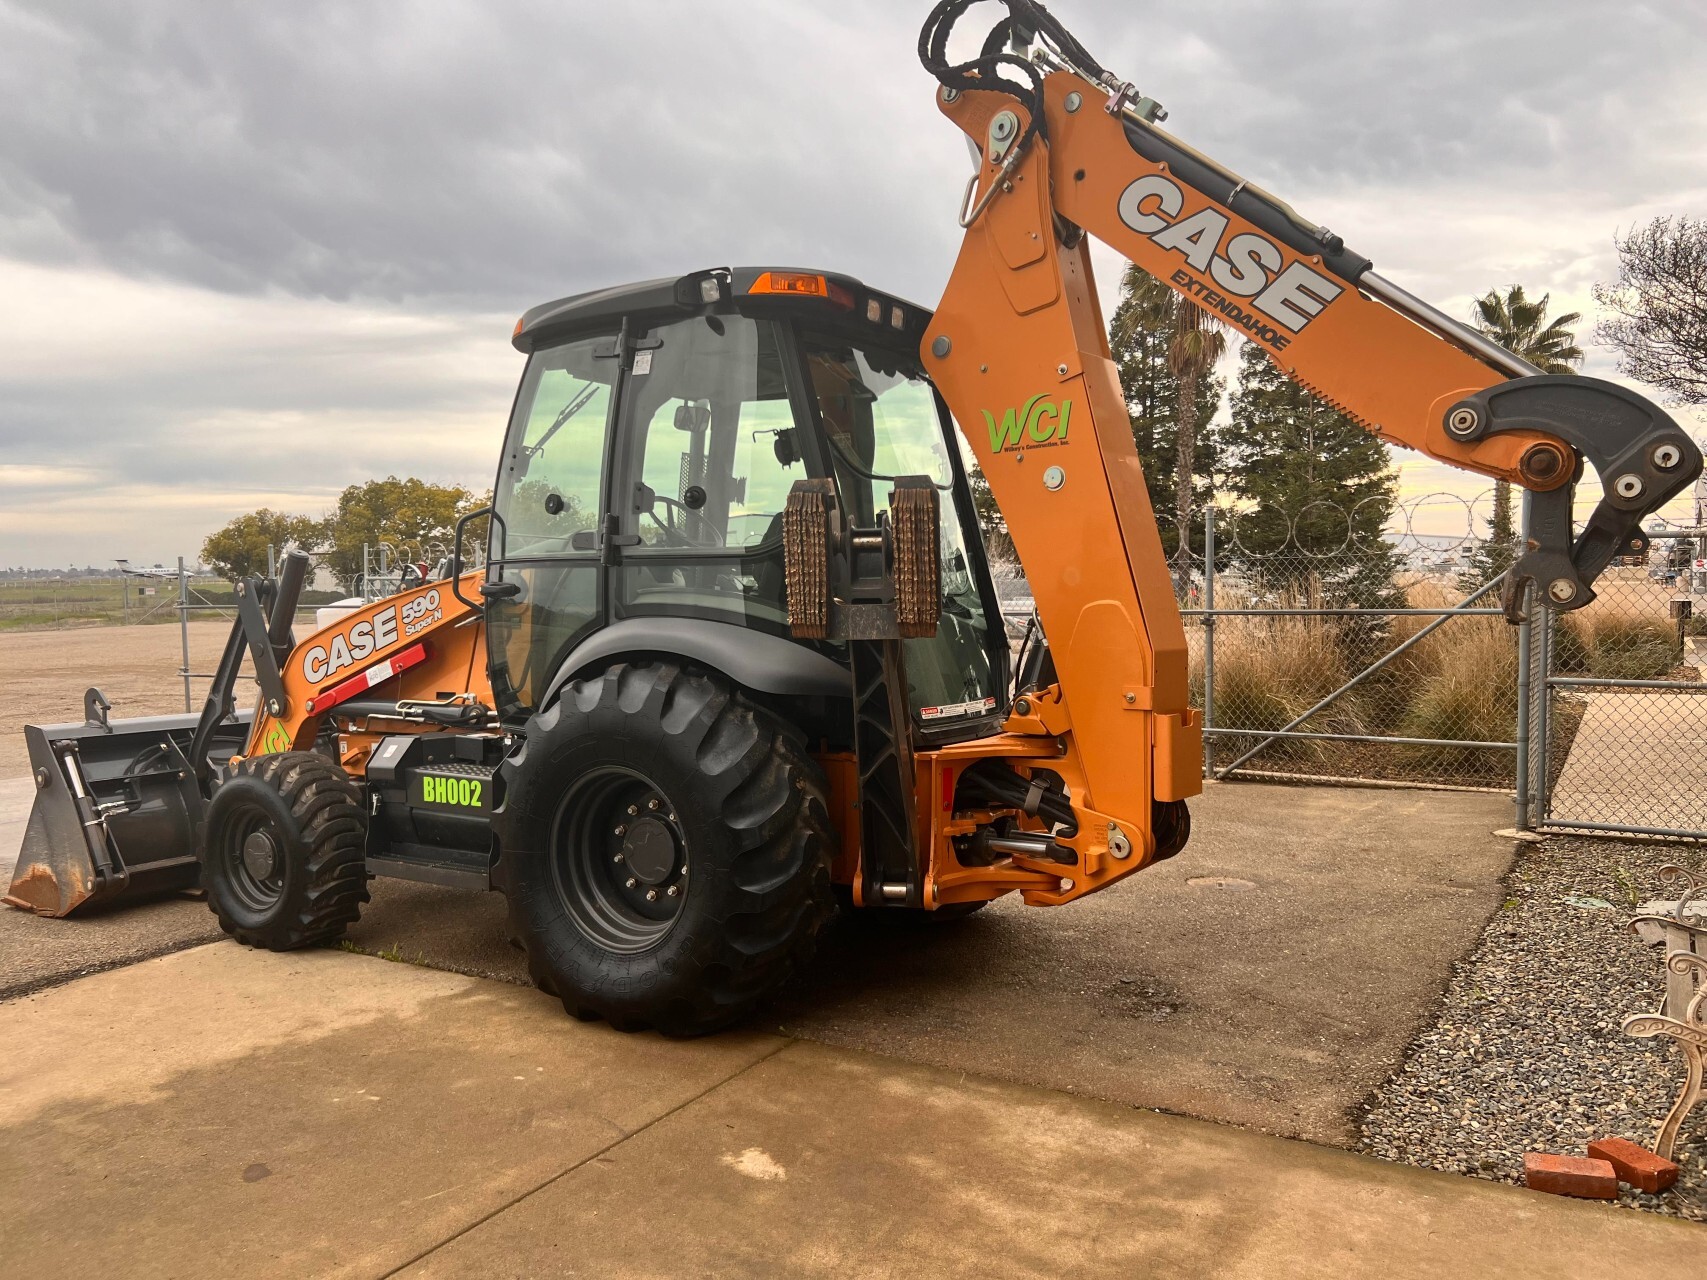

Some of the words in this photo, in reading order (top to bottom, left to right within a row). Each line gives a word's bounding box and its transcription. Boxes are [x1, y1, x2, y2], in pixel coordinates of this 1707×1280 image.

[1117, 173, 1346, 335] CASE
[1170, 269, 1291, 351] EXTENDAHOE
[980, 393, 1072, 454] WCI
[401, 589, 440, 624] 590
[405, 616, 434, 636] Super
[433, 608, 442, 622] N
[303, 604, 398, 685] CASE
[424, 776, 482, 807] BH002
